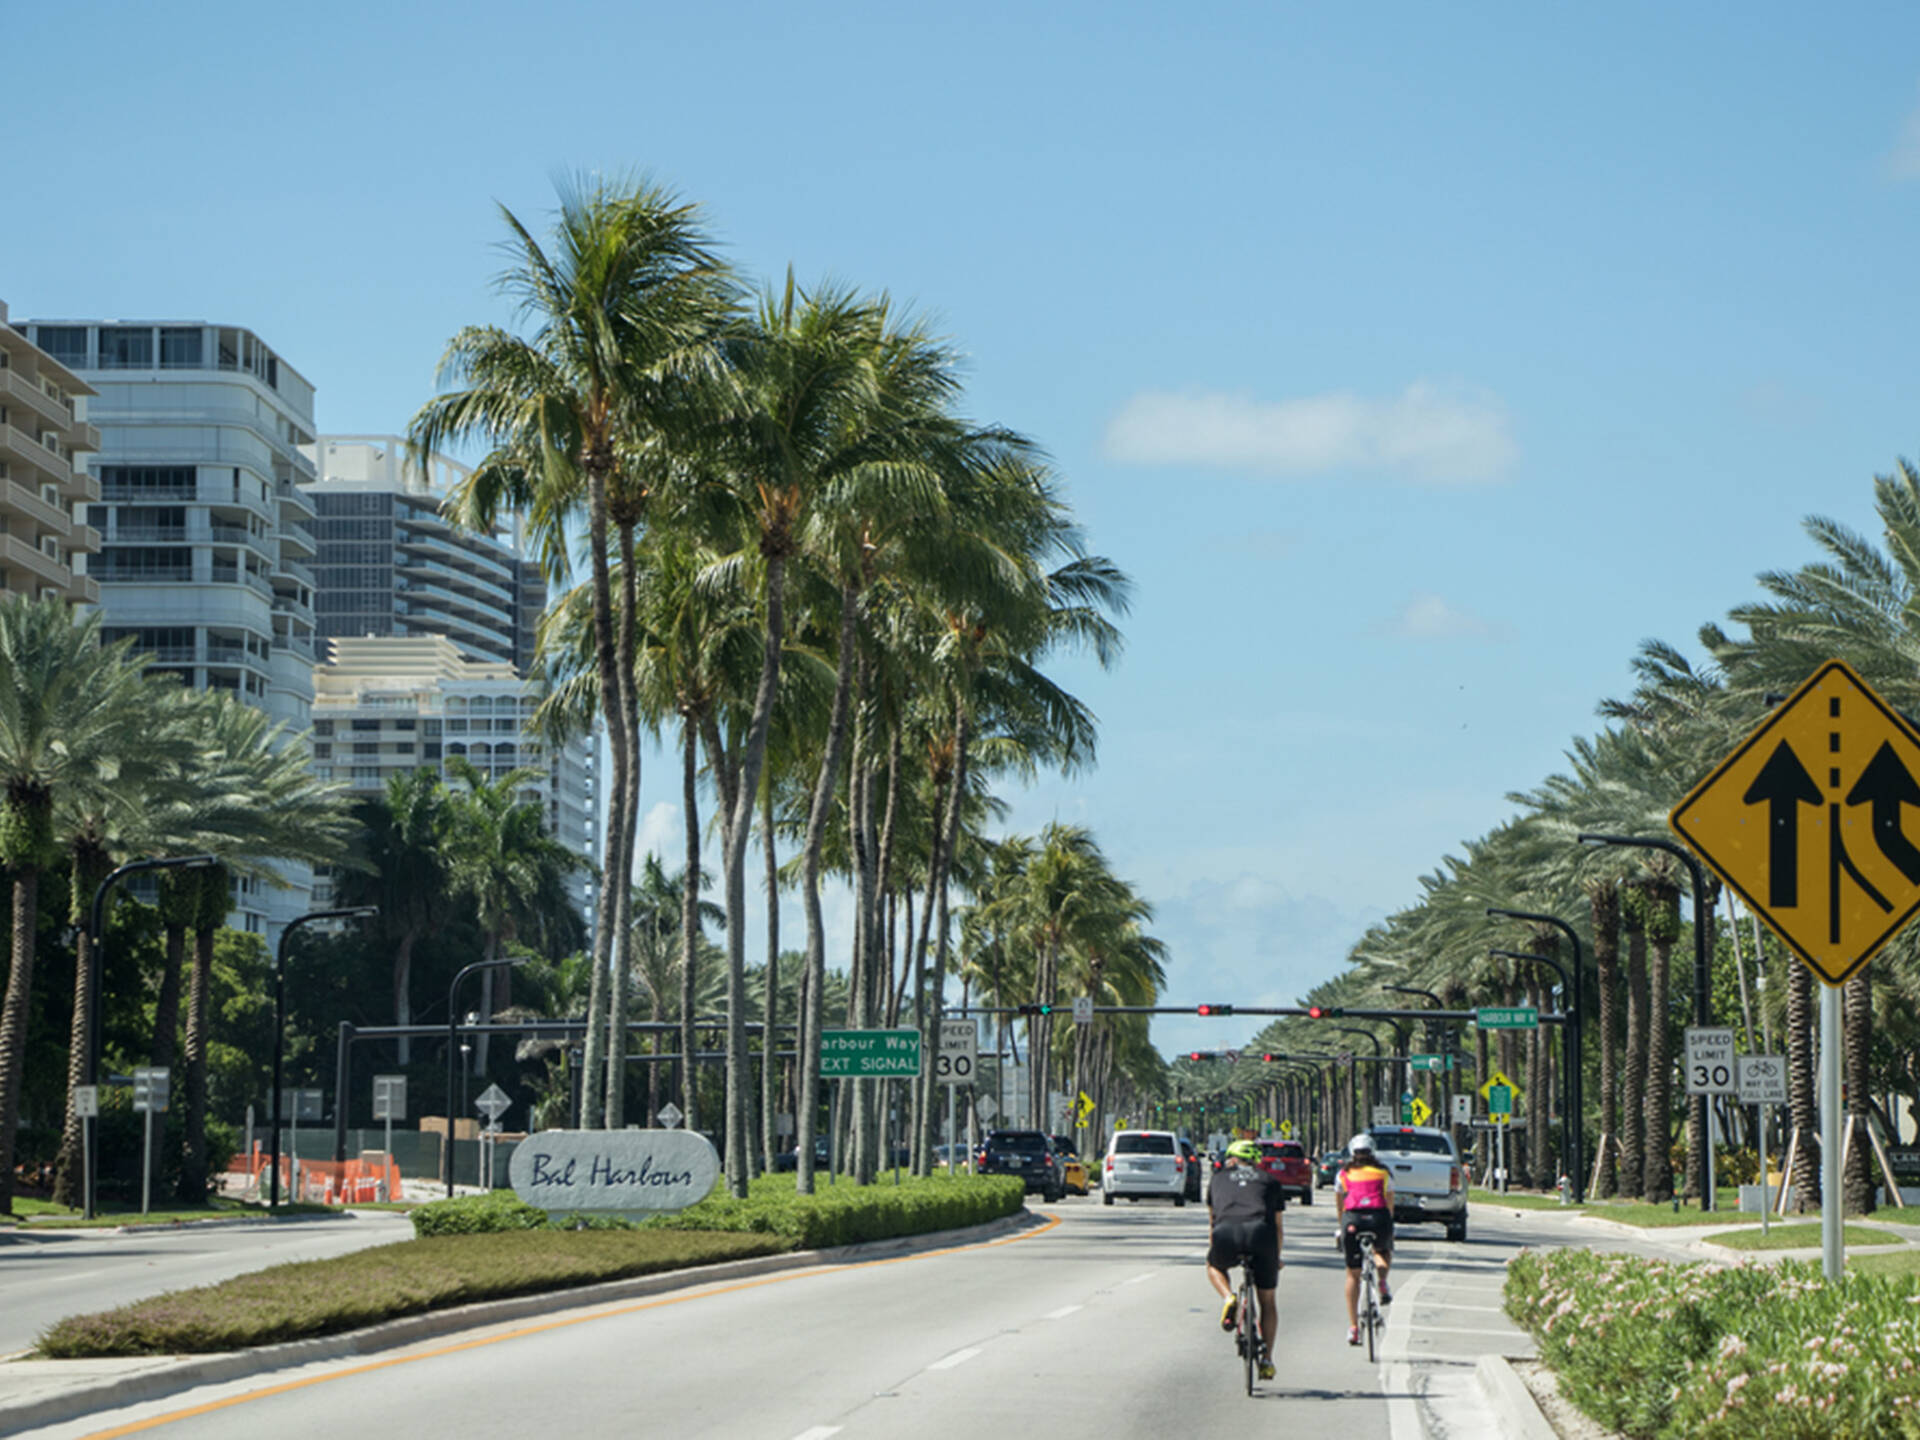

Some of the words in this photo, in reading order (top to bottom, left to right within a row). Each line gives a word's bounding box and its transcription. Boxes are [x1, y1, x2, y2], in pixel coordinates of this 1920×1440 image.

[942, 1025, 974, 1036] PEED
[821, 1037, 875, 1050] arbour
[885, 1036, 919, 1052] Way
[941, 1040, 969, 1050] IMIT
[1690, 1034, 1731, 1046] SPEED
[1694, 1050, 1726, 1060] LIMIT
[821, 1057, 851, 1072] EXT
[860, 1057, 919, 1072] SIGNAL
[936, 1055, 972, 1077] 30
[1693, 1065, 1730, 1087] 30
[531, 1153, 576, 1187] Bal
[590, 1154, 693, 1187] Harbour
